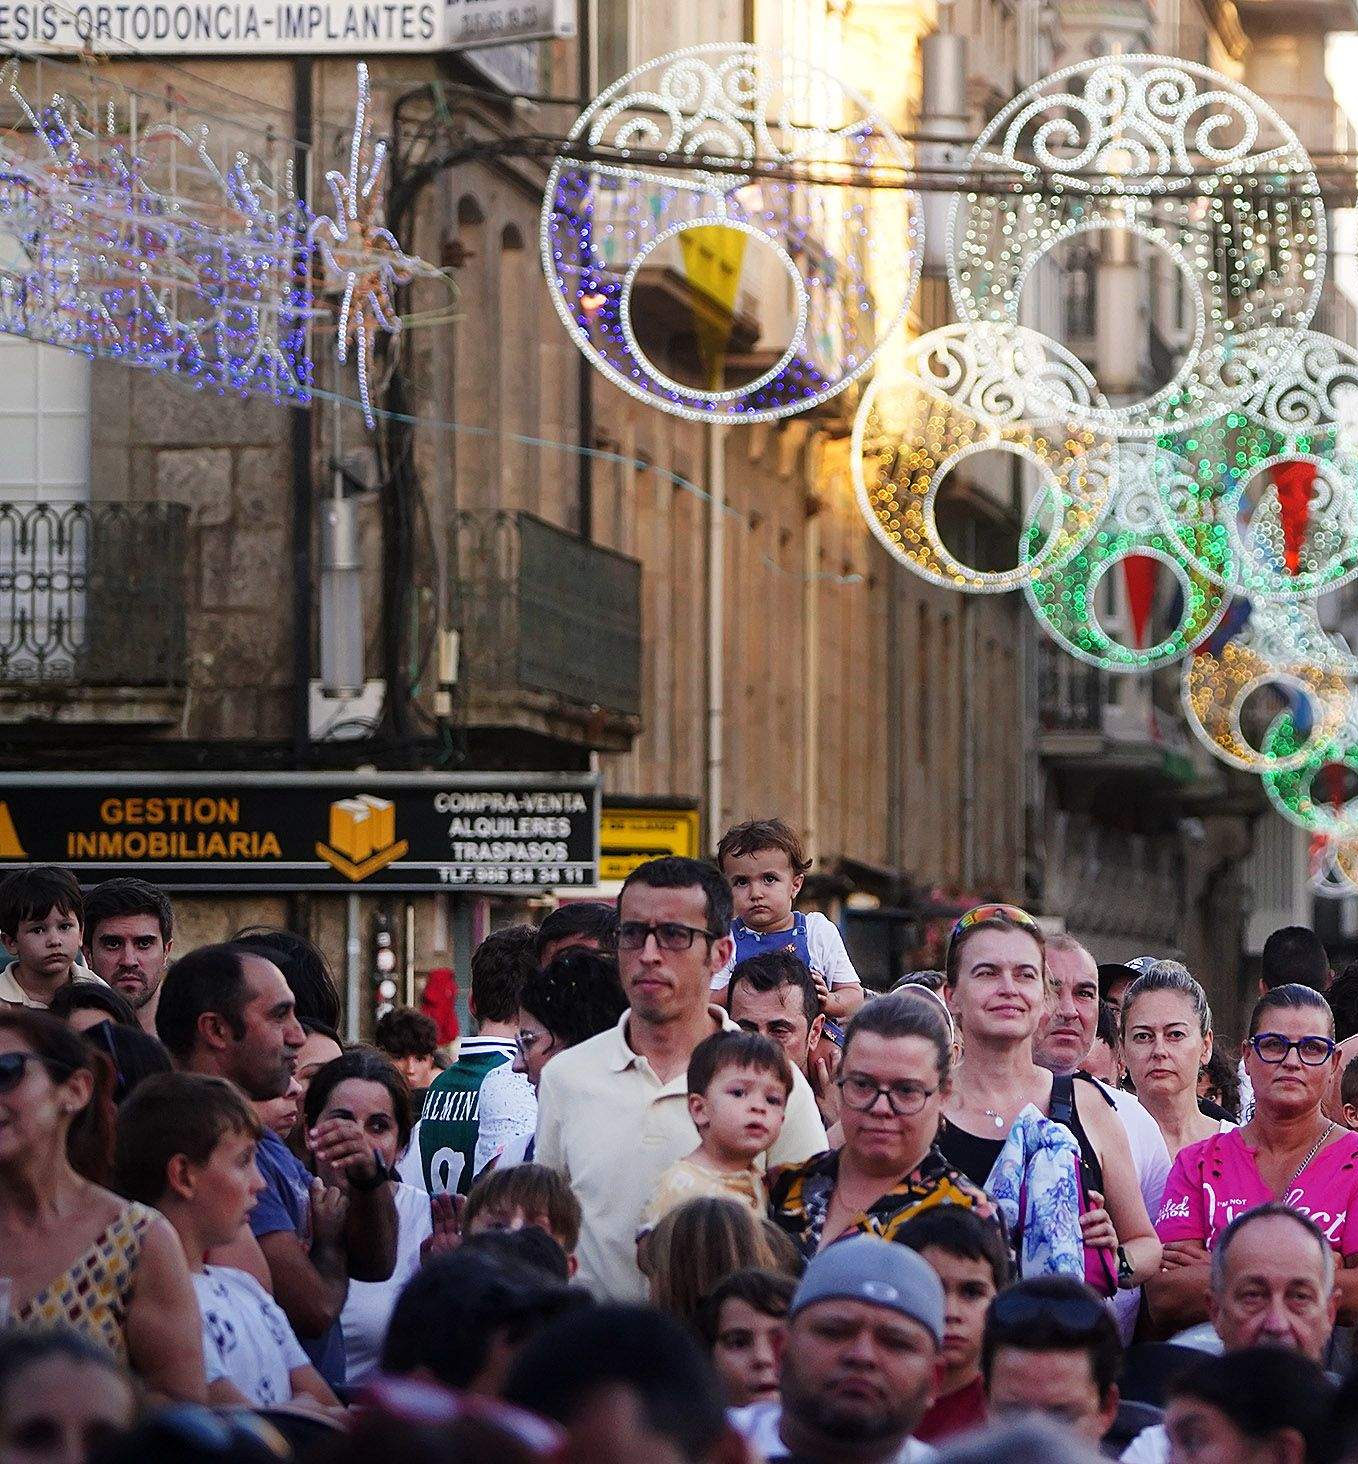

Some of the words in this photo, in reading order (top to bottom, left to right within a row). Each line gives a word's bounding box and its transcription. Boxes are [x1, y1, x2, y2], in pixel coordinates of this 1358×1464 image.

[101, 798, 240, 825] GESTION
[434, 792, 587, 813] COMPRA-VENTA
[449, 816, 572, 838] ALQUILERES
[67, 831, 282, 859] INMOBILIARIA
[452, 841, 569, 861] TRASPASOS
